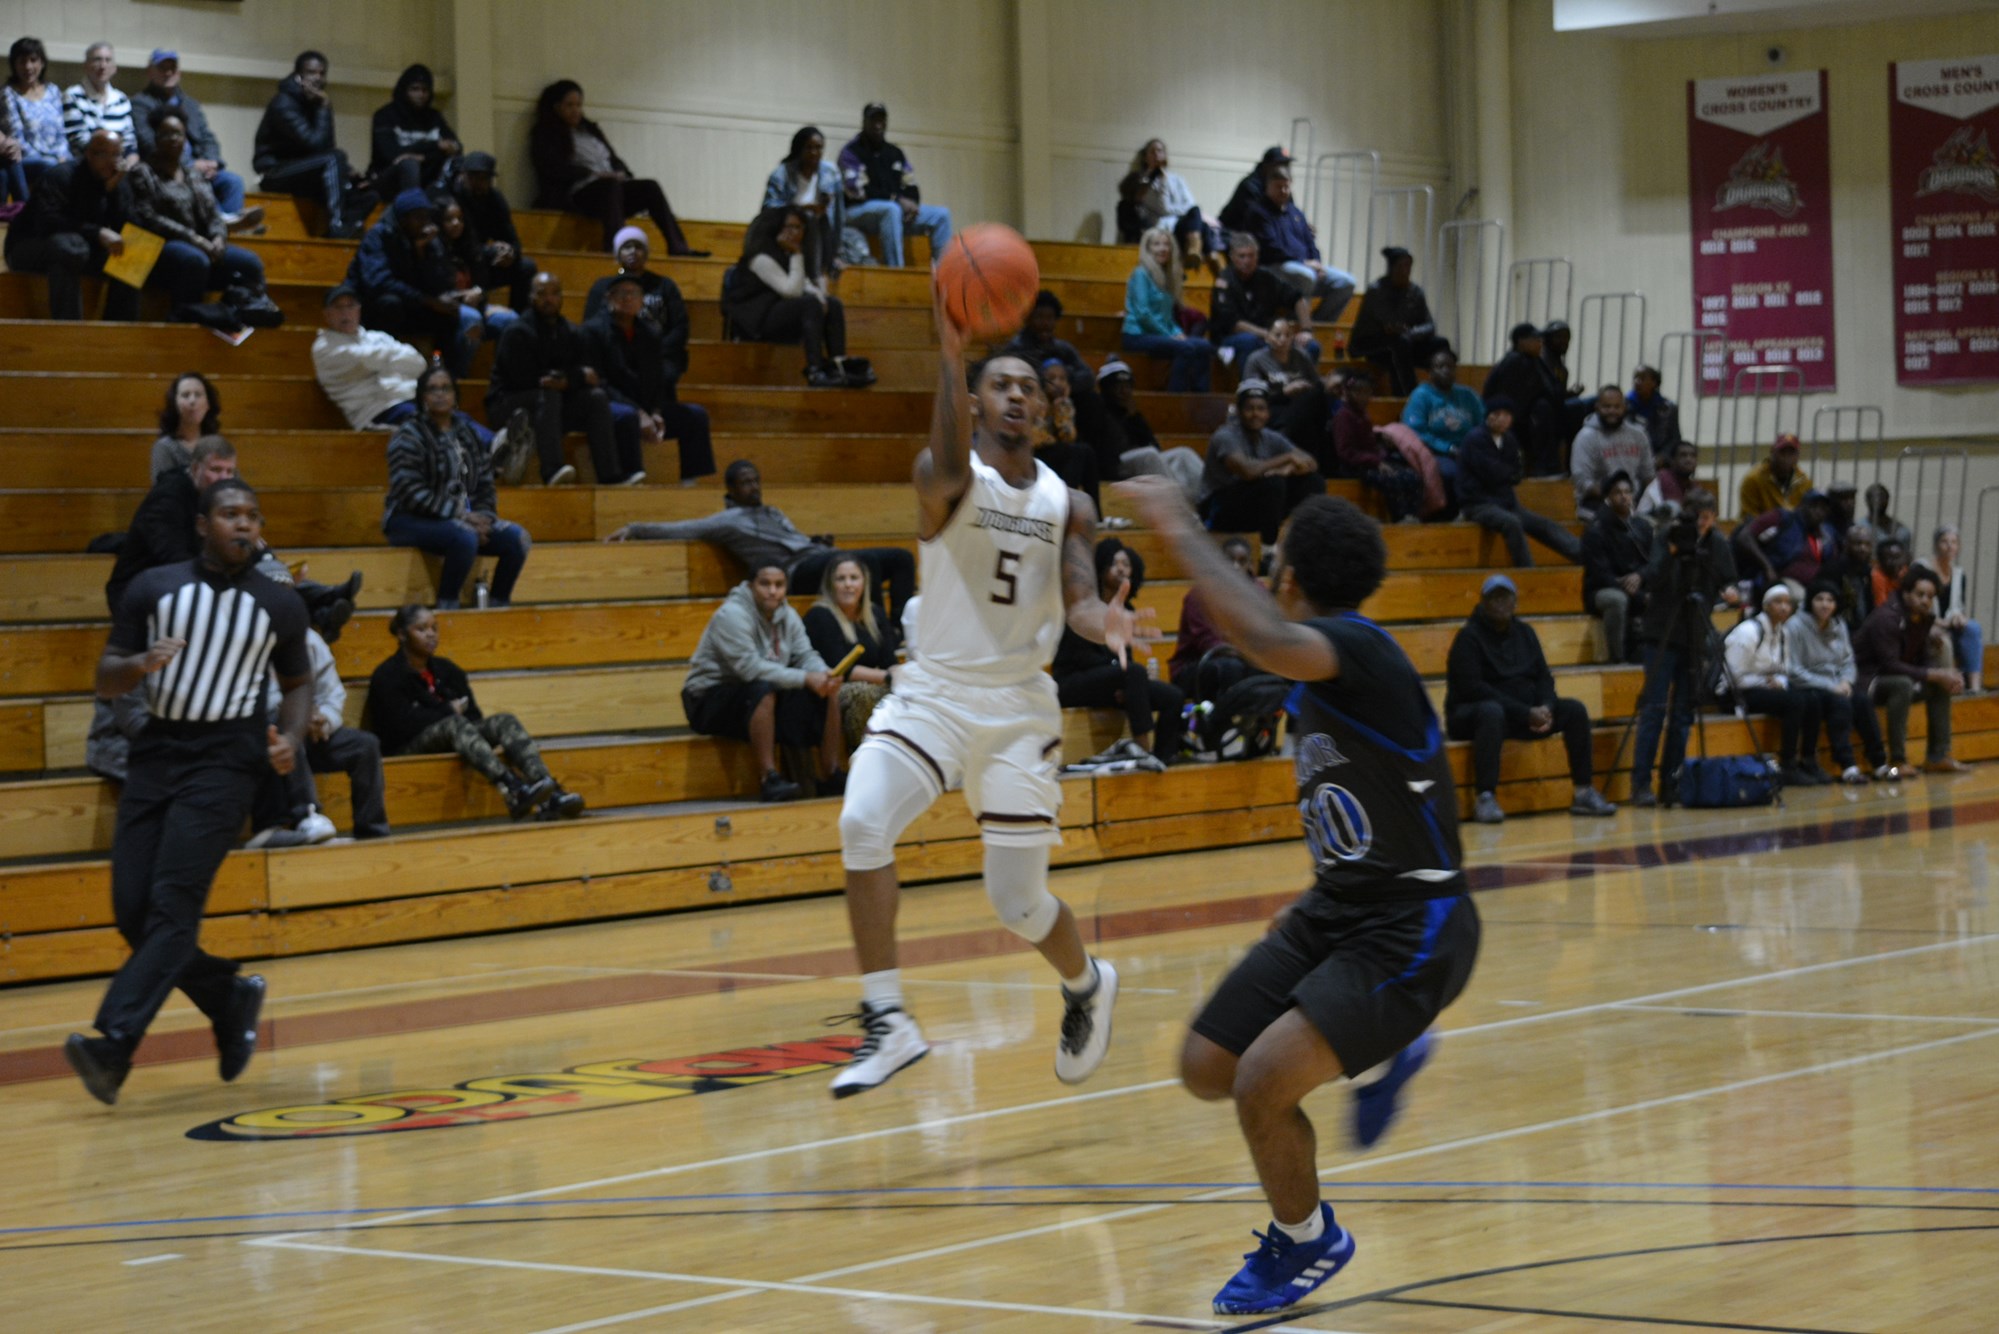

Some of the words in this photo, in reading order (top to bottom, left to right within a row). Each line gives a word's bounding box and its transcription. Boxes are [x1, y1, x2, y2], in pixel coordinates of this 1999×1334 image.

[1940, 66, 1982, 80] MEN'S
[1726, 82, 1788, 98] WOMEN'S
[1903, 84, 1949, 99] CROSS
[1701, 100, 1745, 116] CROSS
[1749, 96, 1812, 112] COUNTRY
[991, 550, 1020, 606] 5
